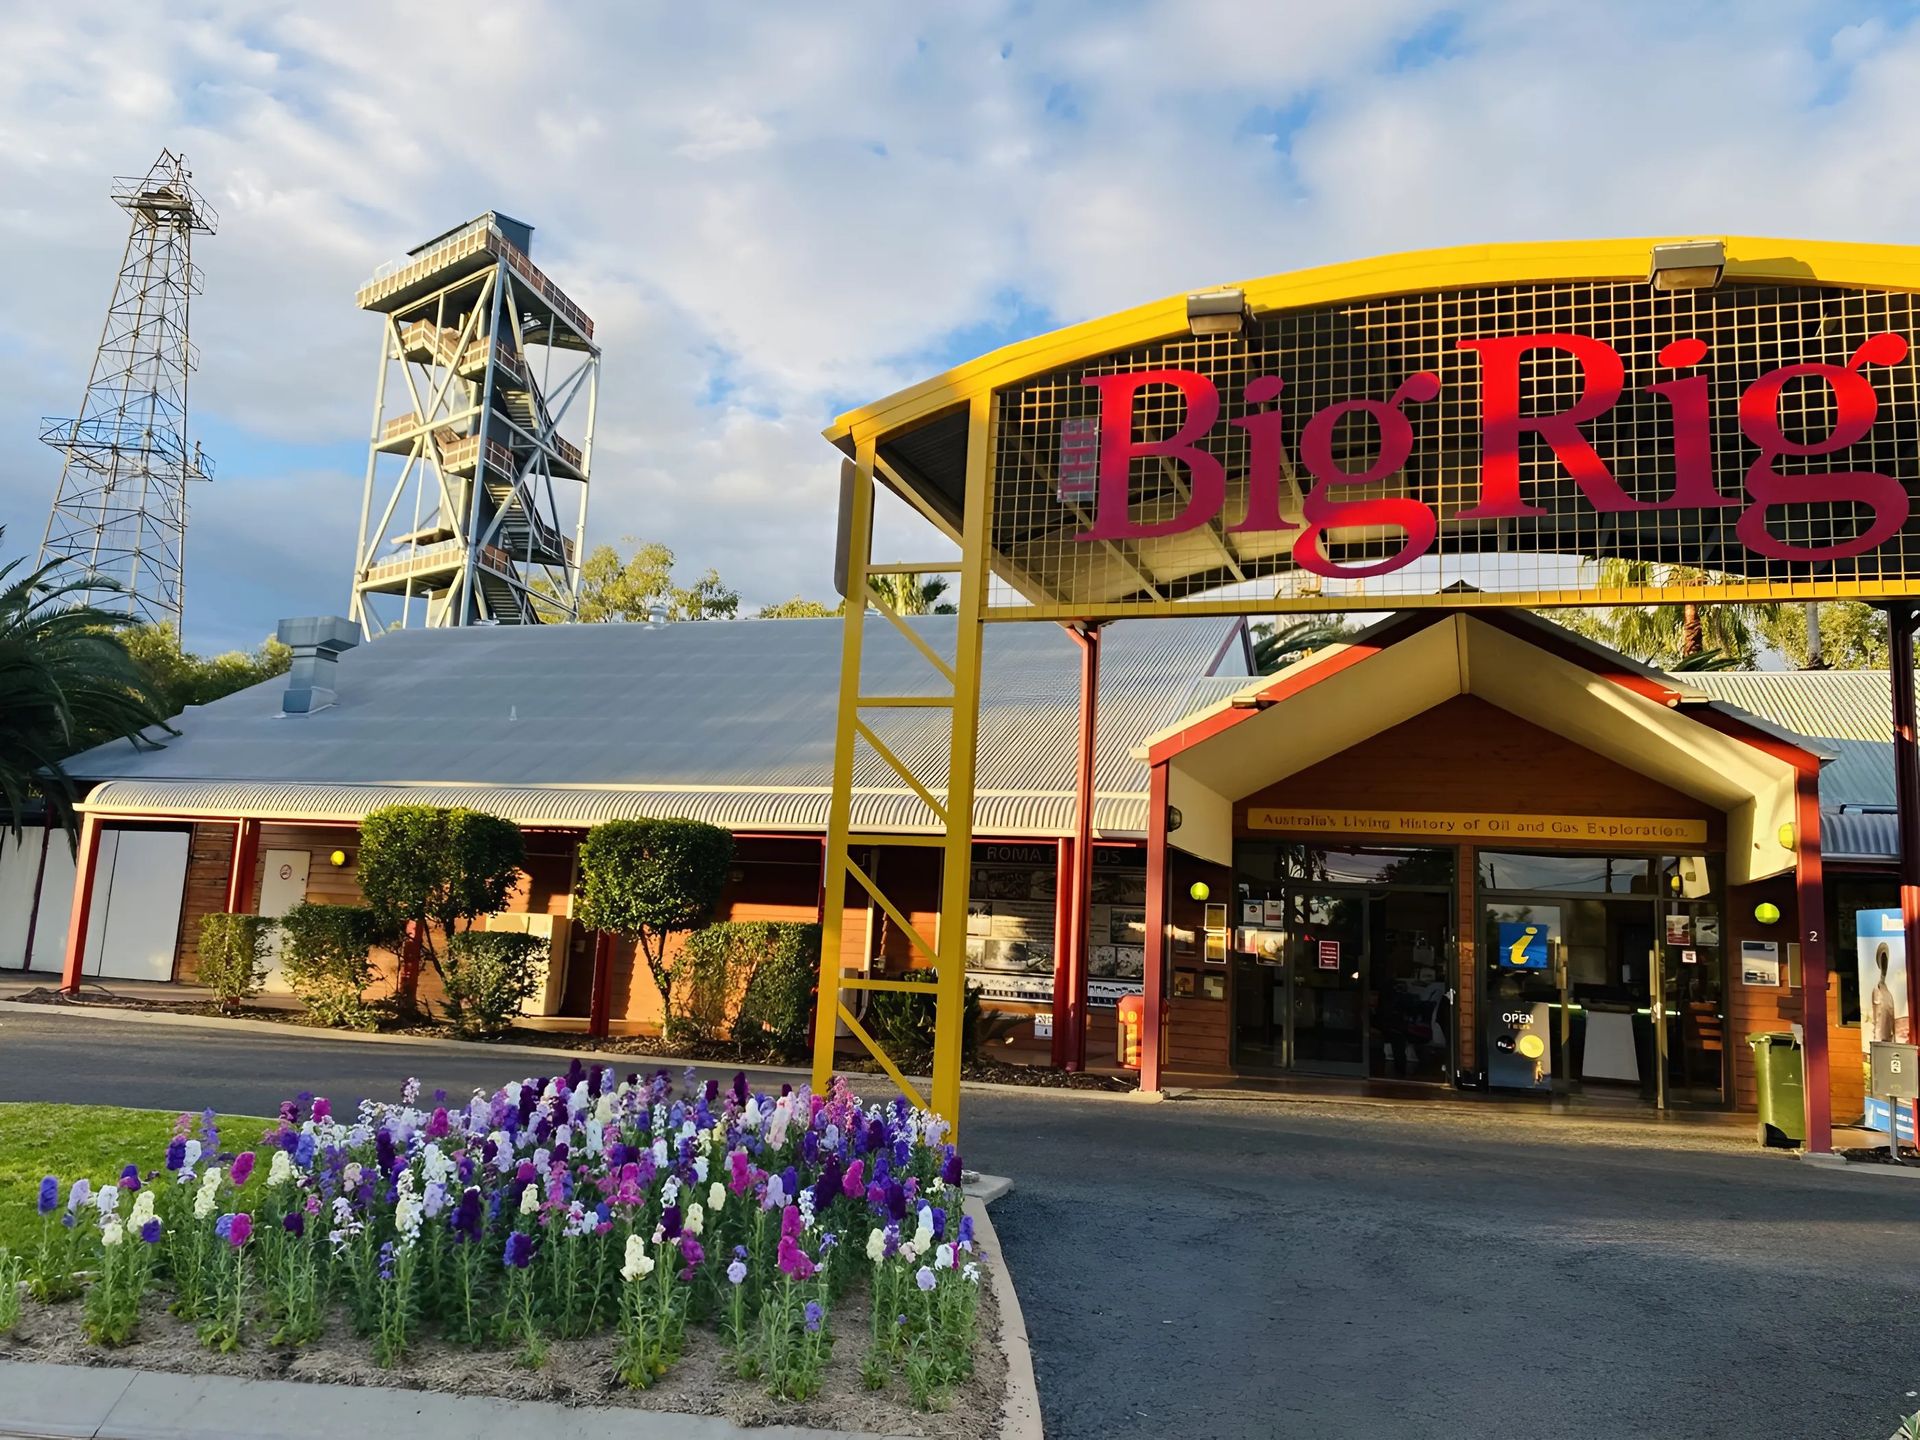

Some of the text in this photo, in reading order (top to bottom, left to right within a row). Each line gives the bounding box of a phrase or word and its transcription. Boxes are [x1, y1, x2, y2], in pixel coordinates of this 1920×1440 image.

[1061, 417, 1095, 500] THE
[1074, 332, 1910, 579] Big Rig
[1263, 813, 1336, 828] Australia's
[1343, 815, 1390, 830] Living
[1399, 816, 1456, 832] History
[1462, 818, 1481, 831] of
[1488, 819, 1510, 831] Oil
[1517, 820, 1545, 832] and
[1551, 821, 1579, 834] Gas
[986, 845, 1042, 862] ROMA
[1808, 930, 1818, 942] 2
[1502, 1012, 1534, 1024] OPEN
